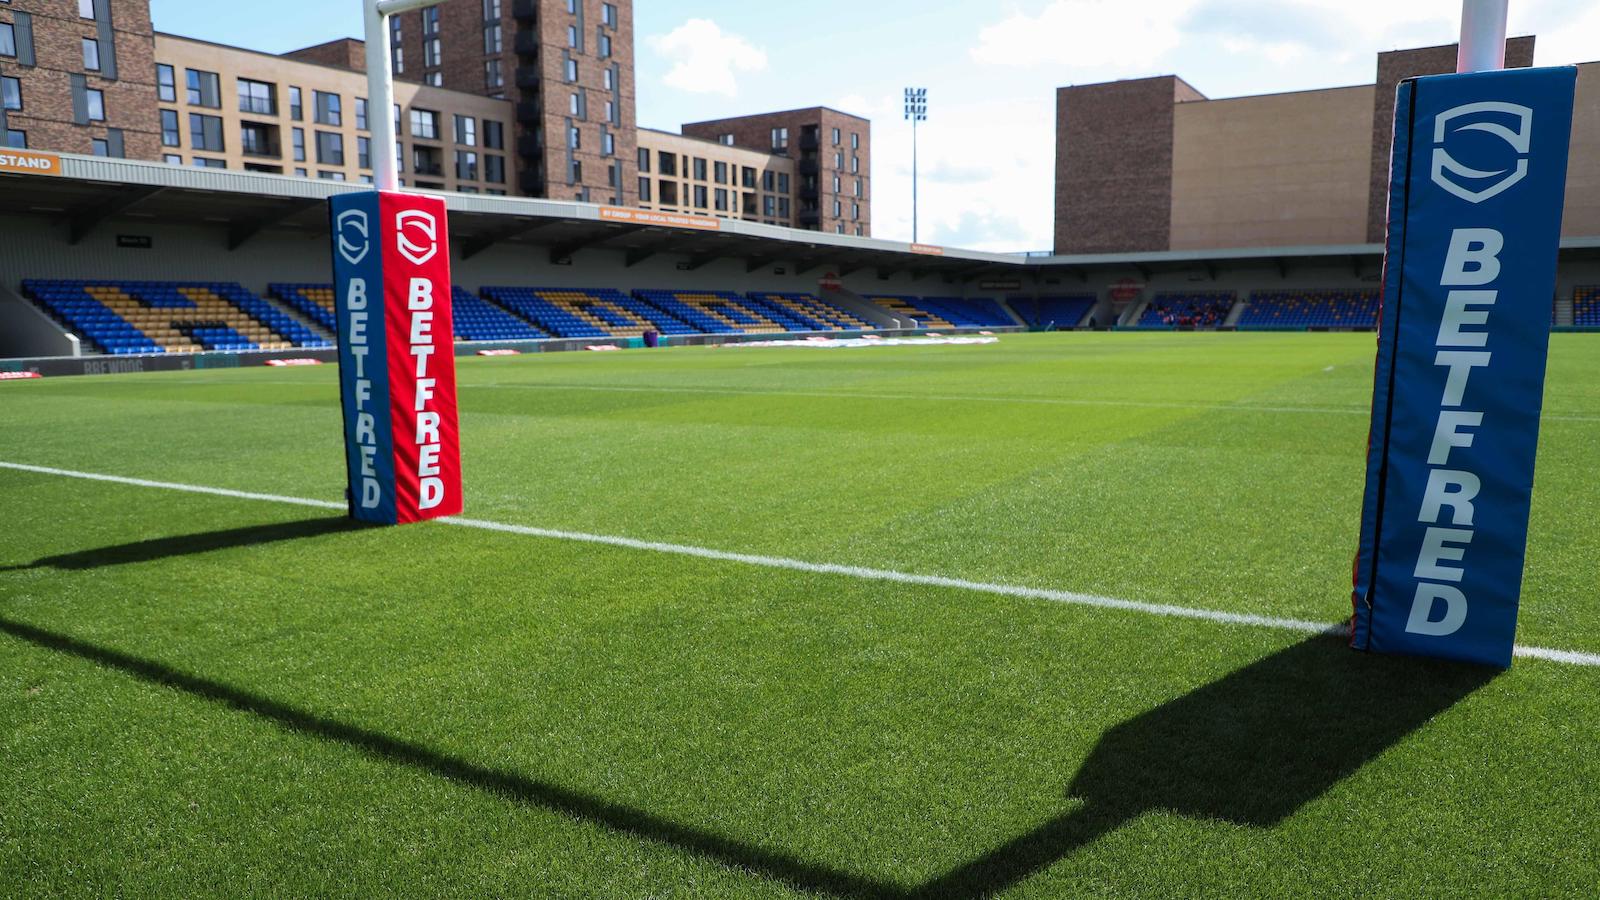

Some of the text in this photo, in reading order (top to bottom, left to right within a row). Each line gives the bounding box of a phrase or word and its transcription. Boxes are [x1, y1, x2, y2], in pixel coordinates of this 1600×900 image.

[0, 154, 52, 170] STAND
[347, 277, 381, 509] BETFRED
[408, 277, 444, 510] BETFRED
[1404, 228, 1504, 636] BETFRED
